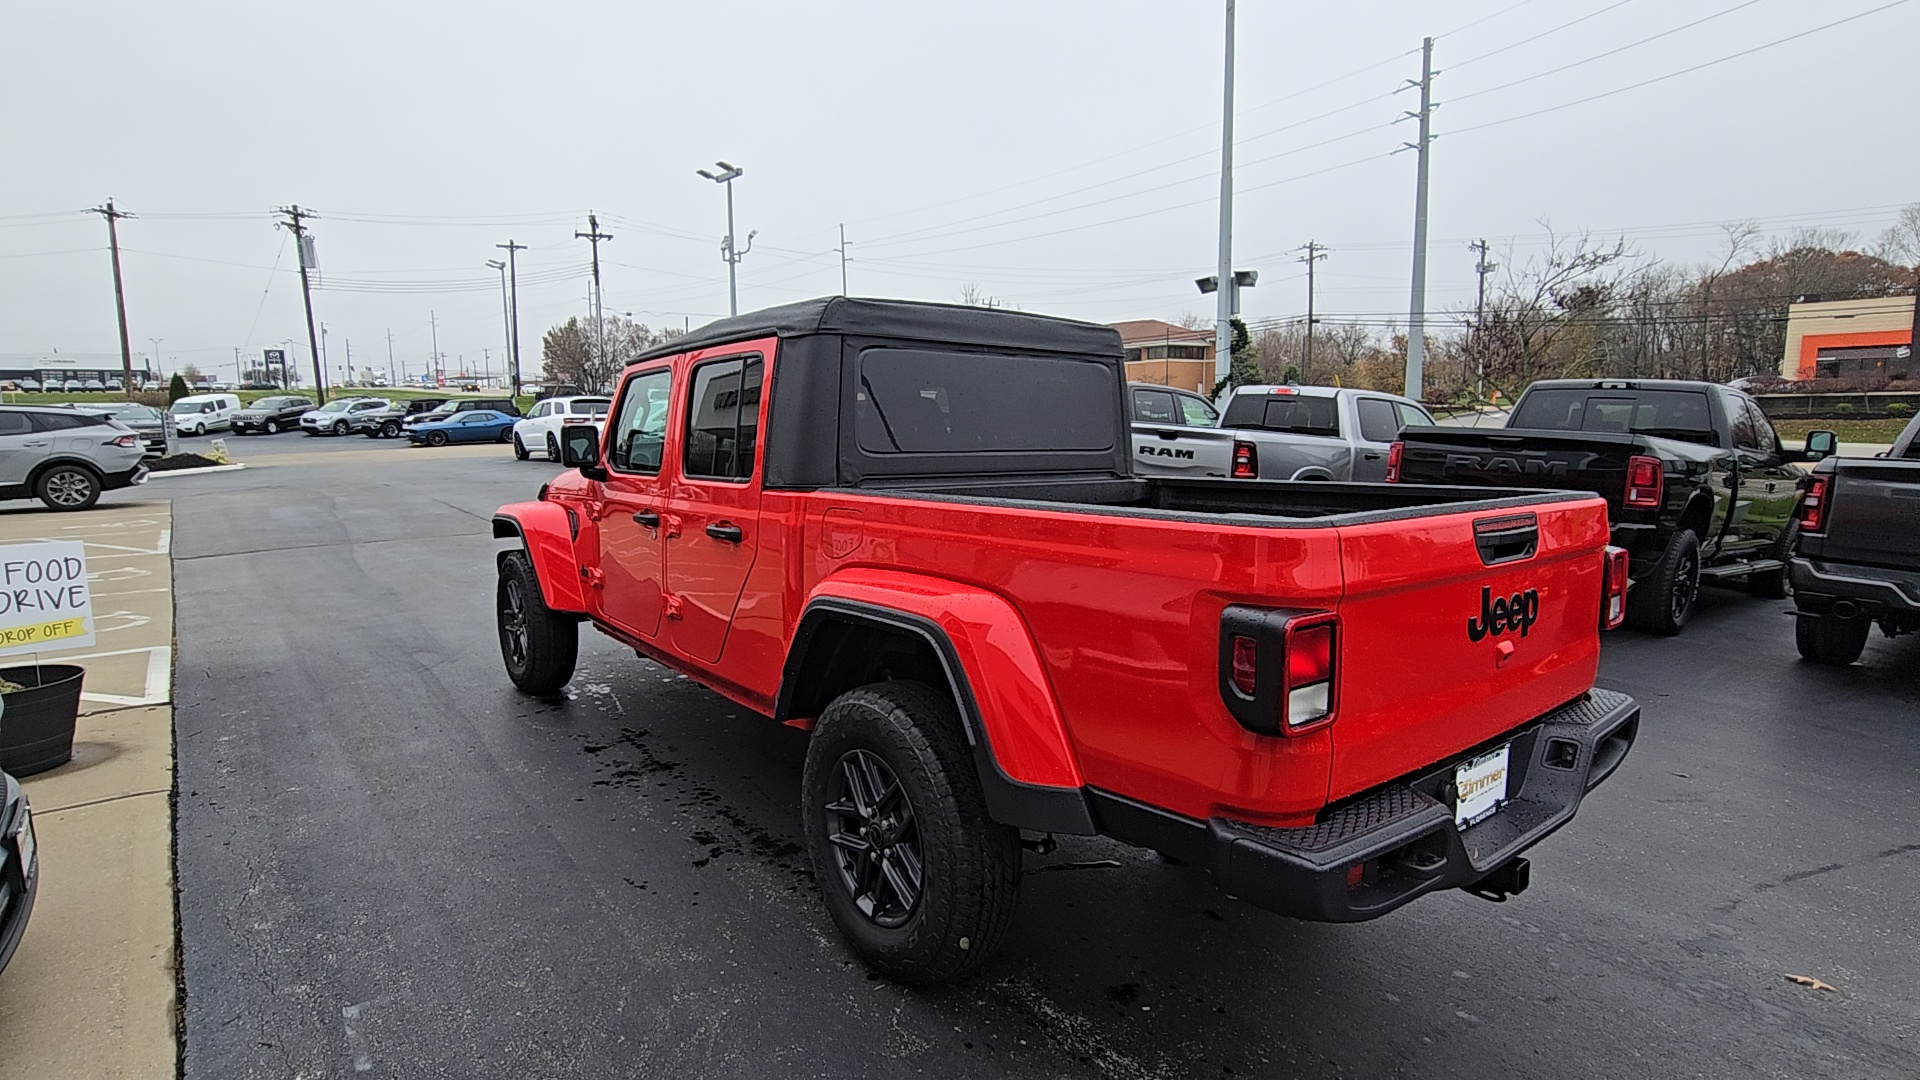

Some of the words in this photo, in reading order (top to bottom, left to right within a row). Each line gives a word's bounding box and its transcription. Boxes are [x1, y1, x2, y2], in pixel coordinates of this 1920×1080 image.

[1138, 445, 1195, 460] RAM
[1443, 453, 1568, 476] RAM
[5, 557, 82, 585] FOOD
[1467, 585, 1538, 642] Jeep
[43, 621, 74, 637] OFF
